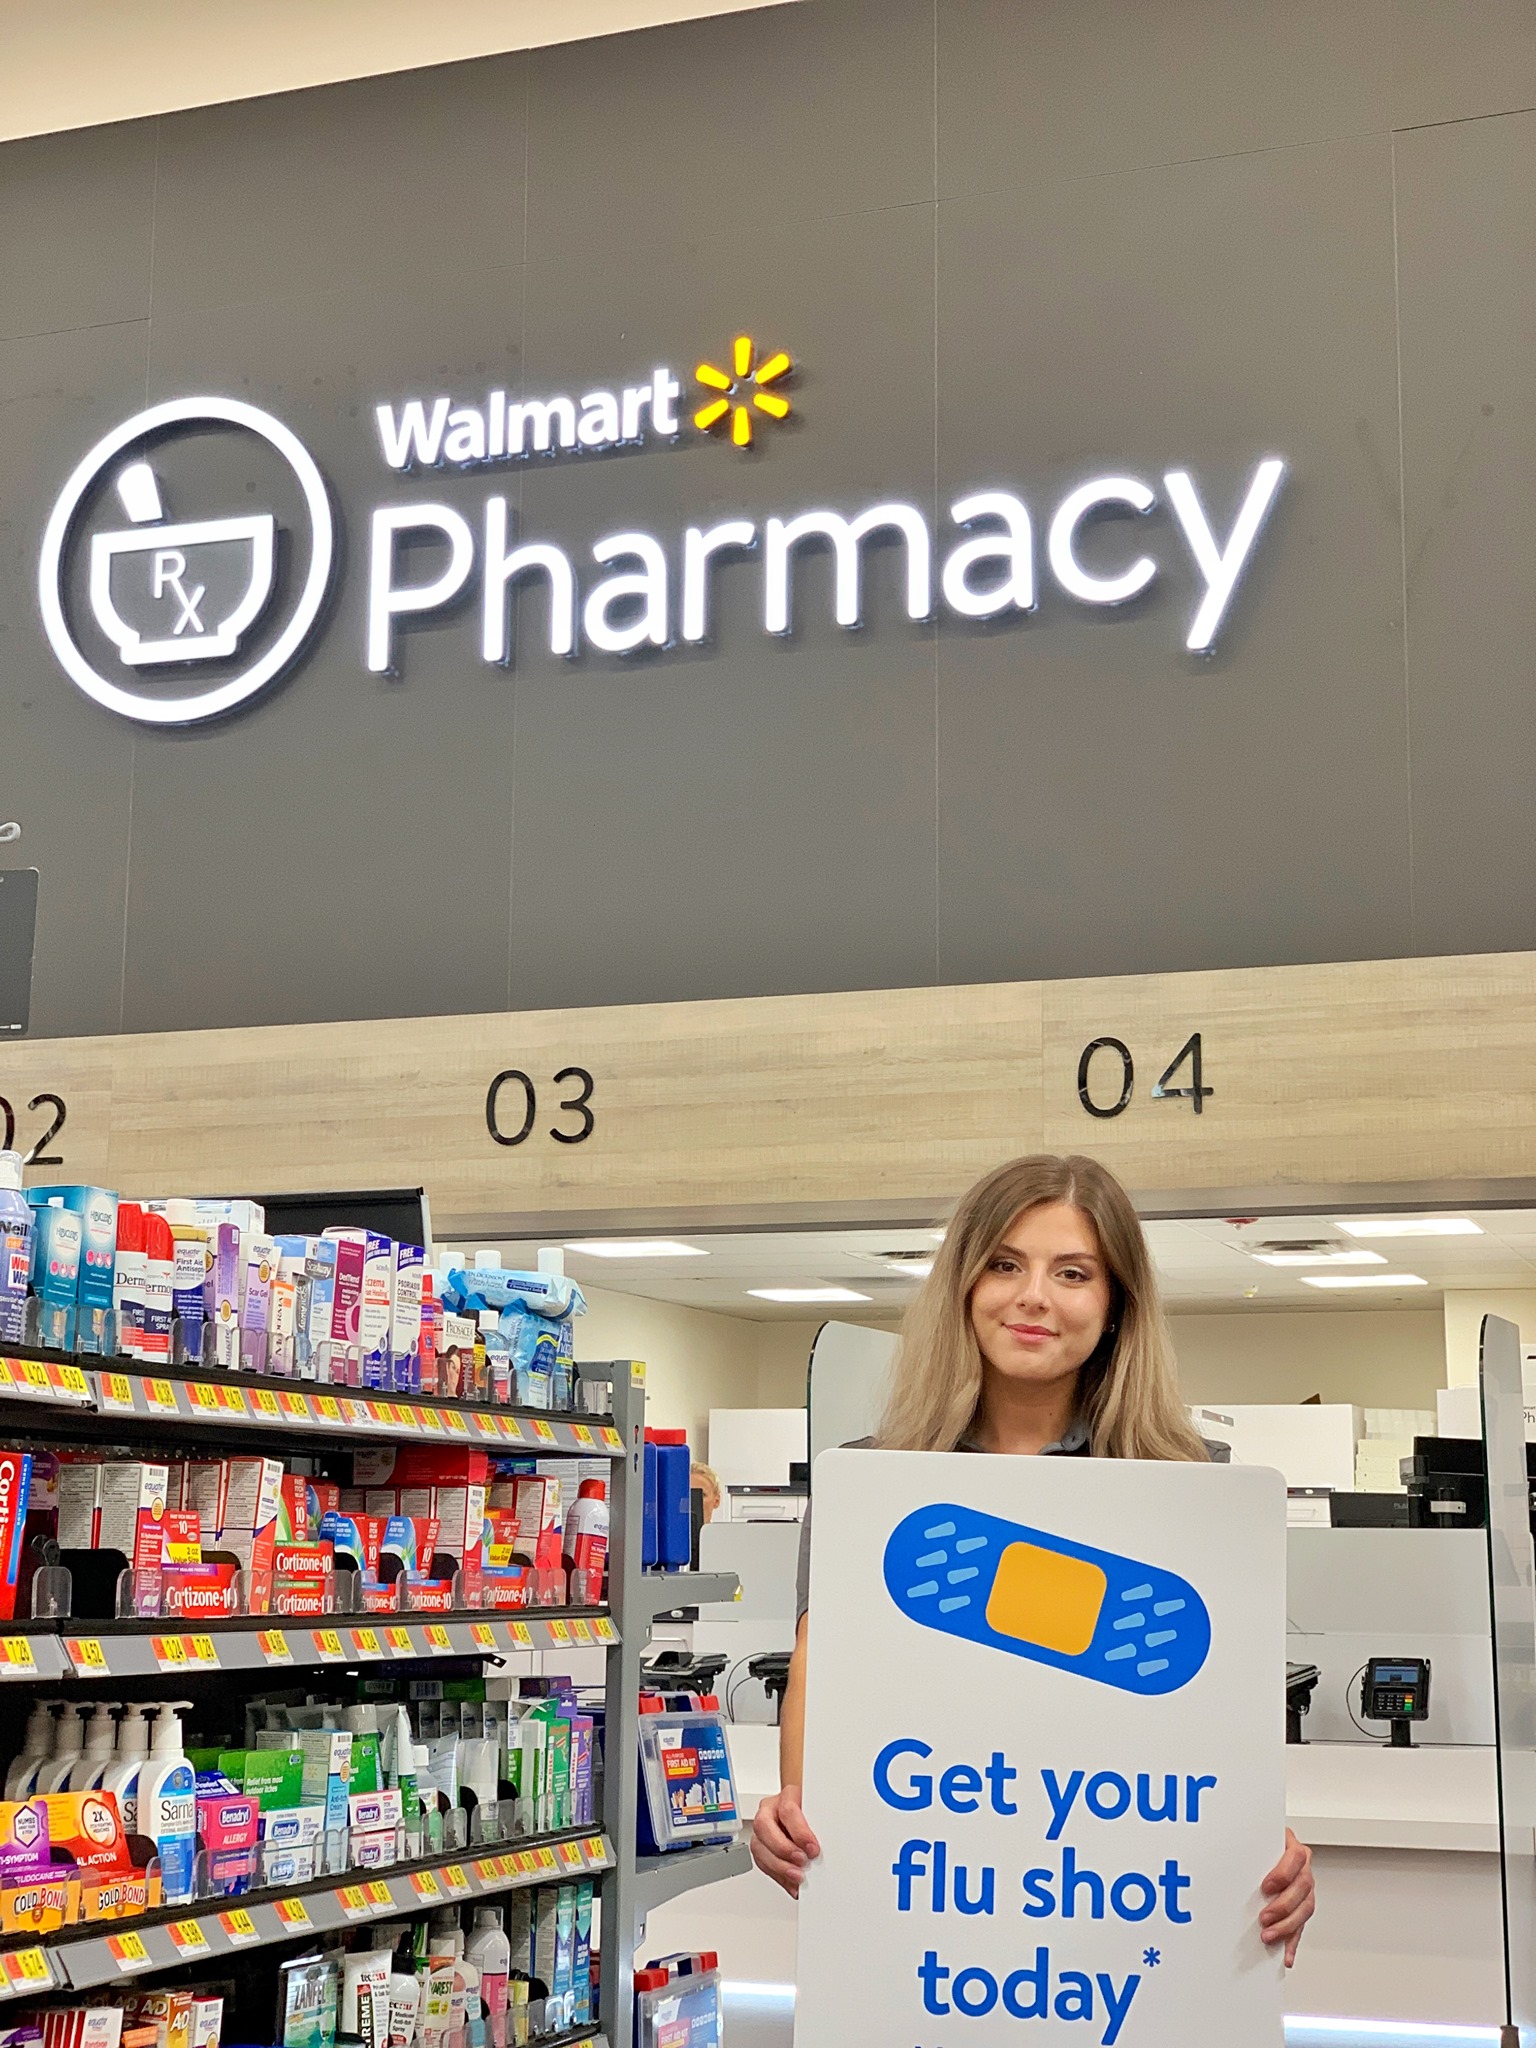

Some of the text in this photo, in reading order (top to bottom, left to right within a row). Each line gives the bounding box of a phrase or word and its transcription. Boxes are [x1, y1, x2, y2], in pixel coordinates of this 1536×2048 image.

[376, 368, 680, 468] Walmart
[368, 460, 1284, 674] Pharmacy
[485, 1067, 595, 1146] 03
[1078, 1034, 1214, 1118] 04
[161, 1800, 194, 1822] Sarna
[222, 1808, 249, 1825] Benadryl
[873, 1738, 1218, 1840] Get your
[88, 1852, 117, 1864] ACTION
[223, 1833, 248, 1845] ALLERGY
[121, 1883, 146, 1905] BOND
[892, 1839, 1193, 1924] flu shot
